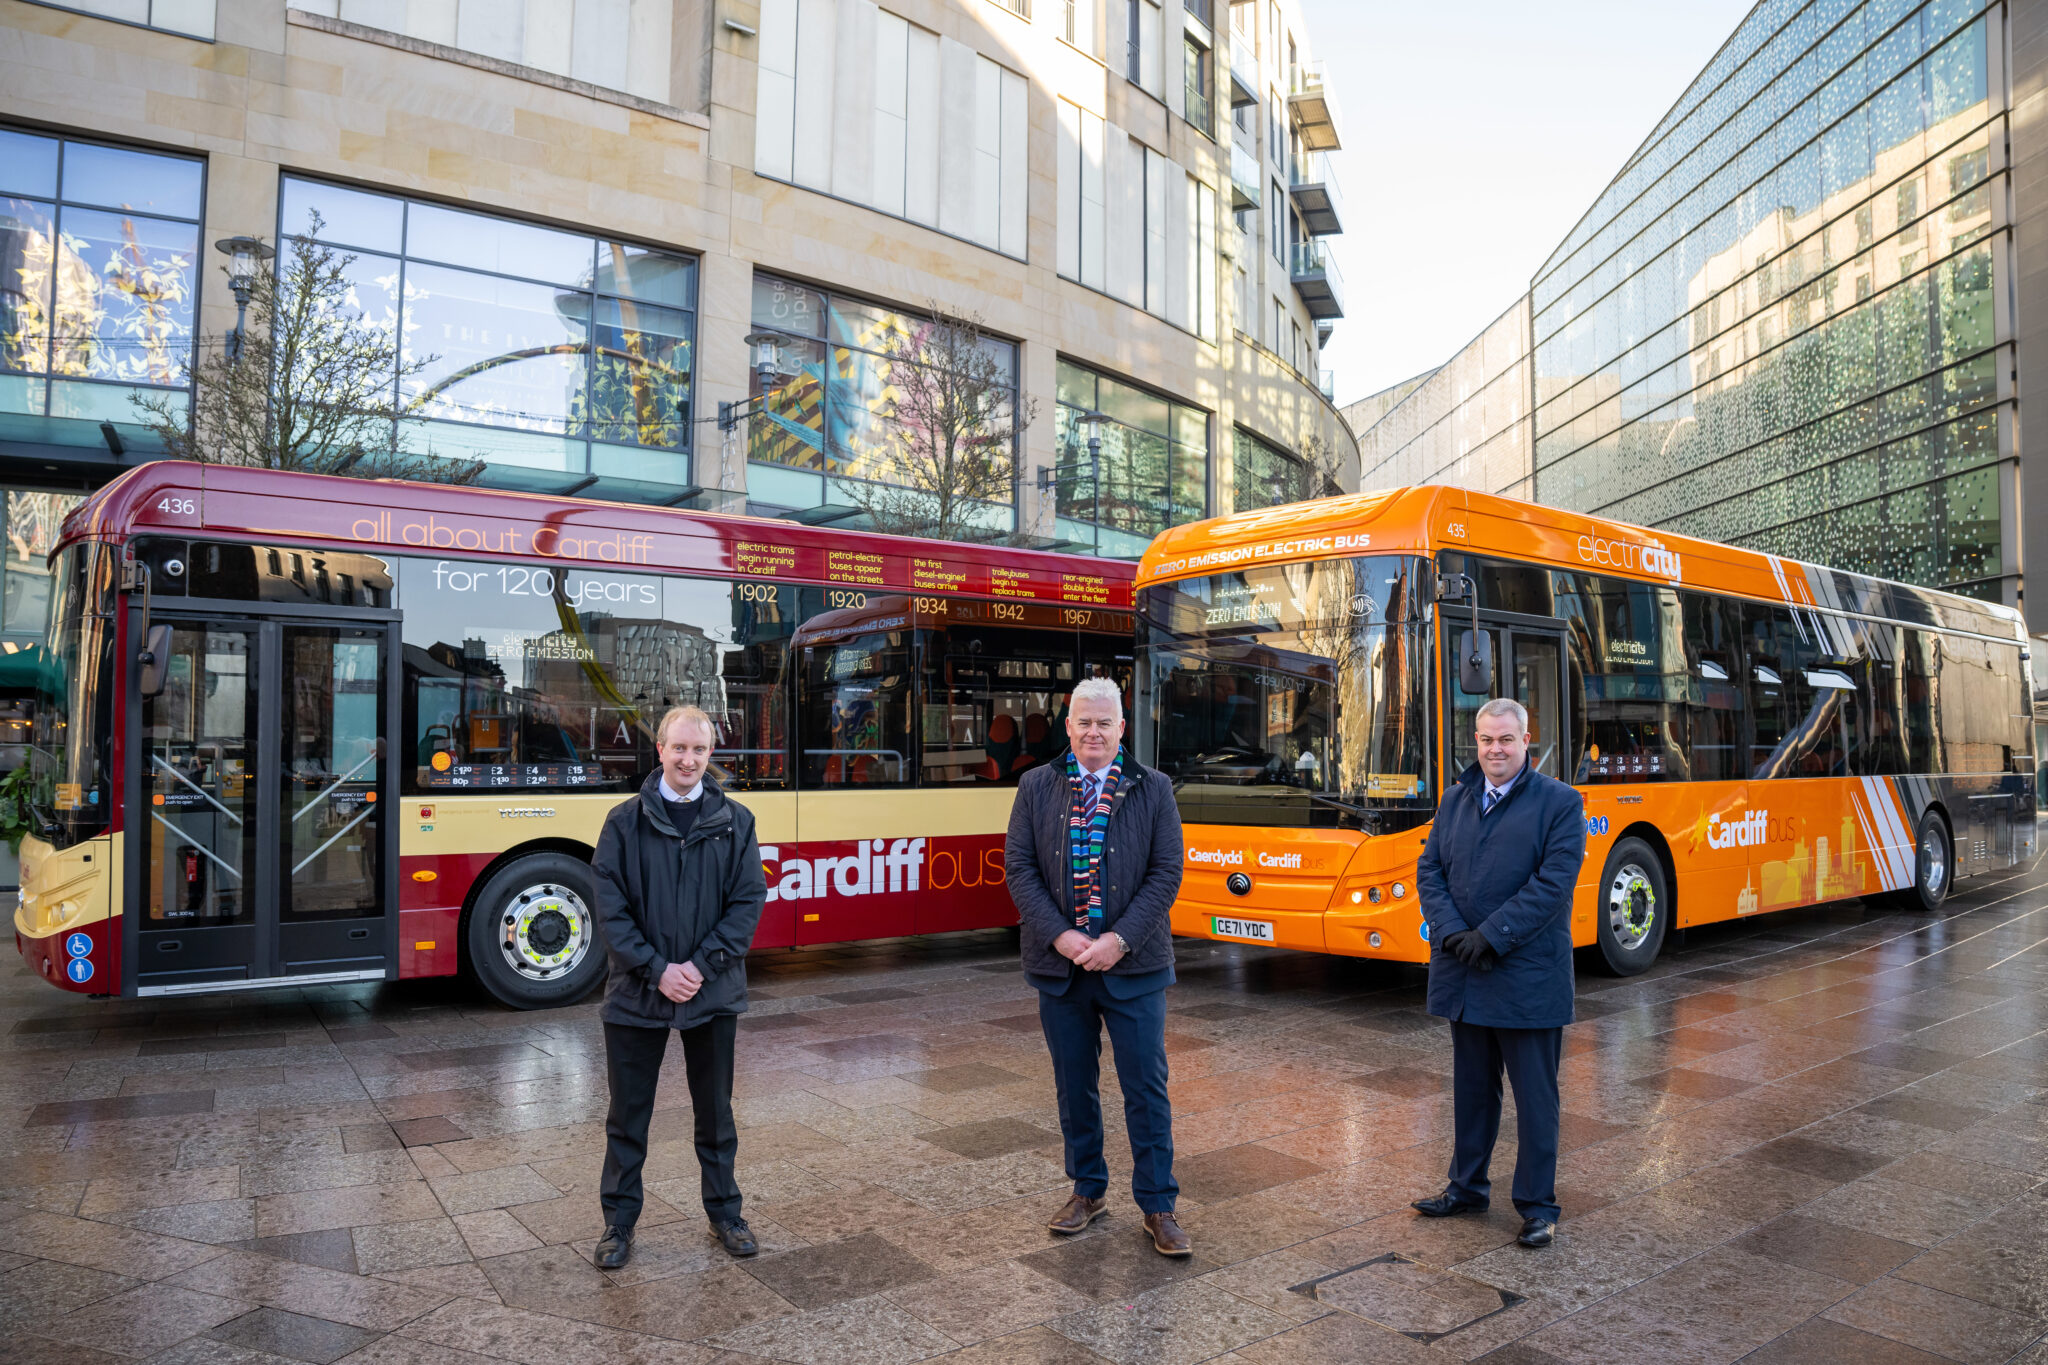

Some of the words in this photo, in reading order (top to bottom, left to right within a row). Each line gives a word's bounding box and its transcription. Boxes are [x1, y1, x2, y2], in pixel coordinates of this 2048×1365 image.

[157, 497, 195, 515] 436
[352, 511, 391, 543] all
[402, 515, 522, 554] about
[532, 527, 655, 563] Cardiff
[1447, 523, 1465, 538] 435
[737, 541, 768, 553] electric
[770, 544, 795, 555] trams
[1153, 558, 1186, 575] ZERO
[1187, 547, 1252, 569] EMISSION
[1254, 537, 1331, 557] ELECTRIC
[1334, 533, 1370, 548] BUS
[737, 552, 761, 564] begin
[763, 557, 795, 568] running
[829, 551, 884, 564] petrol-electric
[914, 558, 927, 568] the
[928, 560, 943, 569] first
[1577, 525, 1682, 588] electricity
[737, 564, 745, 573] in
[747, 564, 777, 575] Cardiff
[829, 561, 852, 571] buses
[853, 564, 882, 575] appear
[914, 569, 966, 583] diesel-engined
[992, 568, 1030, 579] trolleybuses
[432, 561, 489, 592] for
[497, 567, 555, 597] 120
[564, 578, 656, 607] years
[842, 572, 855, 582] the
[856, 574, 884, 585] streets
[914, 579, 936, 590] buses
[937, 582, 958, 591] arrive
[992, 577, 1009, 588] begin
[1010, 579, 1018, 587] to
[1062, 573, 1104, 585] rear-engined
[737, 583, 777, 603] 1902
[992, 587, 1015, 598] replace
[1016, 589, 1035, 598] trams
[1063, 583, 1084, 593] double
[1085, 585, 1110, 595] deckers
[829, 590, 867, 609] 1920
[914, 597, 948, 615] 1934
[1063, 593, 1081, 602] enter
[1081, 593, 1093, 603] the
[1094, 595, 1107, 604] fleet
[992, 603, 1025, 621] 1942
[1063, 609, 1092, 626] 1967
[1205, 606, 1231, 624] ZERO
[1233, 601, 1281, 621] EMISSION
[503, 632, 577, 648] electricity
[1611, 639, 1646, 655] electricity
[487, 644, 524, 657] ZERO
[528, 647, 594, 661] EMISSION
[491, 766, 503, 775] £2
[526, 766, 539, 775] £4
[567, 765, 583, 775] £15
[452, 777, 469, 787] 80p
[1706, 809, 1768, 850] Cardiff
[1768, 809, 1796, 843] bus
[1187, 847, 1243, 867] Caerdydd
[1258, 851, 1302, 869] Cardiff
[1301, 854, 1326, 870] bus
[758, 837, 926, 904] Cardiff
[928, 836, 1007, 890] bus
[1217, 919, 1242, 935] CE71
[1244, 922, 1267, 938] YDC
